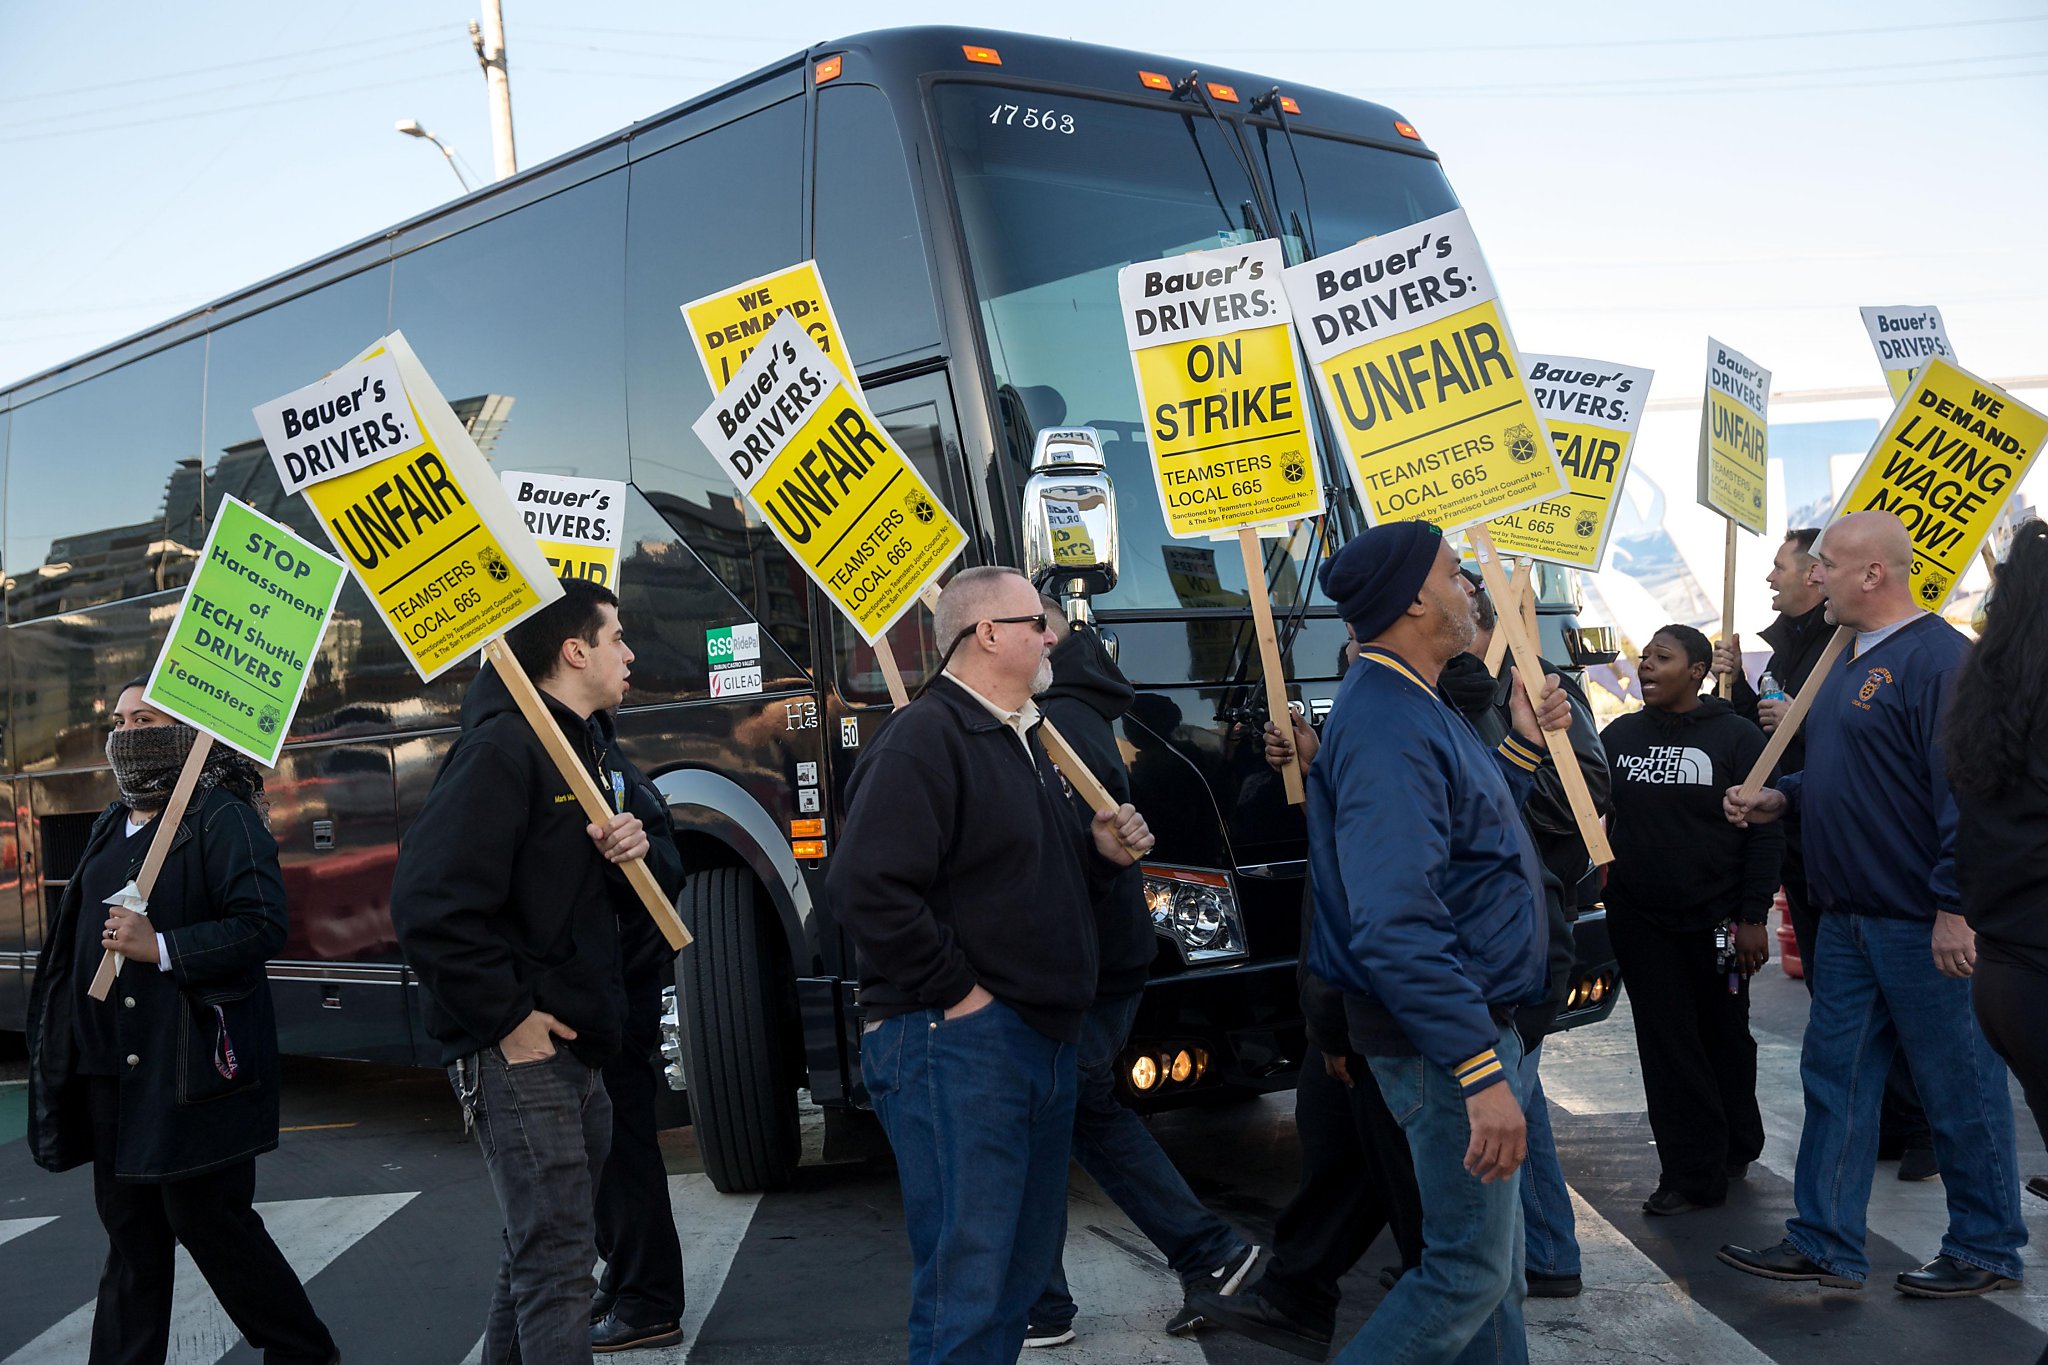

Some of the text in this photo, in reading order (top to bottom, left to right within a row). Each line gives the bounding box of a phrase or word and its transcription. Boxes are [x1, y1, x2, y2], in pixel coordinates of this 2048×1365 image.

[989, 104, 1075, 134] 17563
[1144, 256, 1264, 298] Bauer's
[1315, 233, 1453, 302] Bauer's
[737, 288, 773, 312] WE
[1135, 289, 1277, 337] DRIVERS:
[1311, 266, 1477, 346] DRIVERS:
[1877, 313, 1936, 333] Bauer's
[1187, 338, 1242, 383] ON
[1717, 349, 1763, 388] Bauer's
[1878, 337, 1950, 360] DRIVERS:
[716, 340, 797, 441] Bauer's
[1332, 322, 1514, 431] UNFAIR
[1529, 362, 1634, 392] Bauer's
[1712, 367, 1764, 414] DRIVERS:
[282, 376, 387, 440] Bauer's
[729, 366, 829, 480] DRIVERS:
[1155, 381, 1293, 442] STRIKE
[1534, 388, 1630, 423] RIVERS:
[1918, 388, 2027, 461] DEMAND:
[1970, 389, 2005, 420] WE
[283, 412, 410, 484] DRIVERS:
[1551, 431, 1621, 483] FAIR
[1712, 401, 1764, 466] UNFAIR
[1895, 415, 2012, 496] LIVING
[765, 407, 888, 544] UNFAIR
[1163, 454, 1272, 486] TEAMSTERS
[1366, 434, 1495, 491] TEAMSTERS
[1712, 458, 1751, 492] TEAMSTERS
[1712, 474, 1732, 495] LOCAL
[332, 451, 466, 570] UNFAIR
[517, 482, 611, 511] Bauer's
[1169, 479, 1263, 508] LOCAL 665
[1172, 510, 1208, 520] Sanctioned
[1208, 508, 1217, 516] by
[1218, 502, 1252, 513] Teamsters
[1253, 498, 1270, 506] Joint
[1270, 494, 1296, 504] Council
[1375, 464, 1488, 517] LOCAL 665
[1427, 507, 1438, 516] by
[1438, 493, 1479, 511] Teamsters
[1479, 485, 1500, 497] Joint
[1500, 474, 1530, 490] Council
[1530, 470, 1545, 478] No.
[1545, 466, 1550, 474] 7
[1444, 502, 1482, 519] Francisco
[1483, 493, 1506, 506] Labor
[1507, 482, 1537, 498] Council
[1881, 450, 1988, 525] WAGE
[523, 510, 611, 542] RIVERS:
[1208, 516, 1220, 524] San
[1221, 510, 1254, 522] Francisco
[1255, 505, 1274, 515] Labor
[1275, 500, 1301, 511] Council
[1493, 516, 1555, 534] CAL 665
[1862, 487, 1966, 559] NOW!
[246, 533, 311, 580] STOP
[828, 508, 904, 592] TEAMSTERS
[1510, 532, 1539, 542] Teamsters
[1540, 538, 1556, 546] Joint
[1556, 541, 1578, 550] Council
[1510, 539, 1538, 548] Francisco
[1538, 544, 1556, 552] Labor
[1556, 548, 1580, 556] Council
[211, 545, 325, 622] Harassment
[389, 560, 476, 623] TEAMSTERS
[845, 536, 912, 612] LOCAL 665
[860, 592, 886, 622] Sanctioned
[885, 586, 893, 595] by
[890, 563, 915, 589] Teamsters
[914, 550, 926, 565] Joint
[924, 532, 942, 552] Council
[940, 526, 949, 534] No.
[880, 602, 892, 613] The
[889, 592, 900, 604] San
[898, 570, 921, 594] Francisco
[919, 556, 934, 572] Labor
[932, 537, 950, 557] Council
[191, 593, 304, 672] TECH Shuttle
[249, 602, 270, 620] of
[404, 587, 482, 646] LOCAL 665
[416, 636, 447, 658] Sanctioned
[446, 630, 454, 638] by
[452, 614, 481, 634] Teamsters
[480, 605, 495, 617] Joint
[493, 592, 514, 608] Council
[512, 586, 524, 595] No.
[438, 645, 450, 655] The
[449, 639, 460, 648] San
[460, 622, 487, 641] Francisco
[486, 612, 502, 625] Labor
[502, 598, 523, 614] Council
[194, 627, 284, 689] DRIVERS
[708, 634, 759, 657] GS9 RidePal
[167, 659, 254, 718] Teamsters
[724, 674, 760, 690] GILEAD
[843, 724, 857, 746] 50
[1648, 746, 1682, 759] THE
[1616, 754, 1680, 770] NORTH
[1626, 768, 1677, 784] FACE
